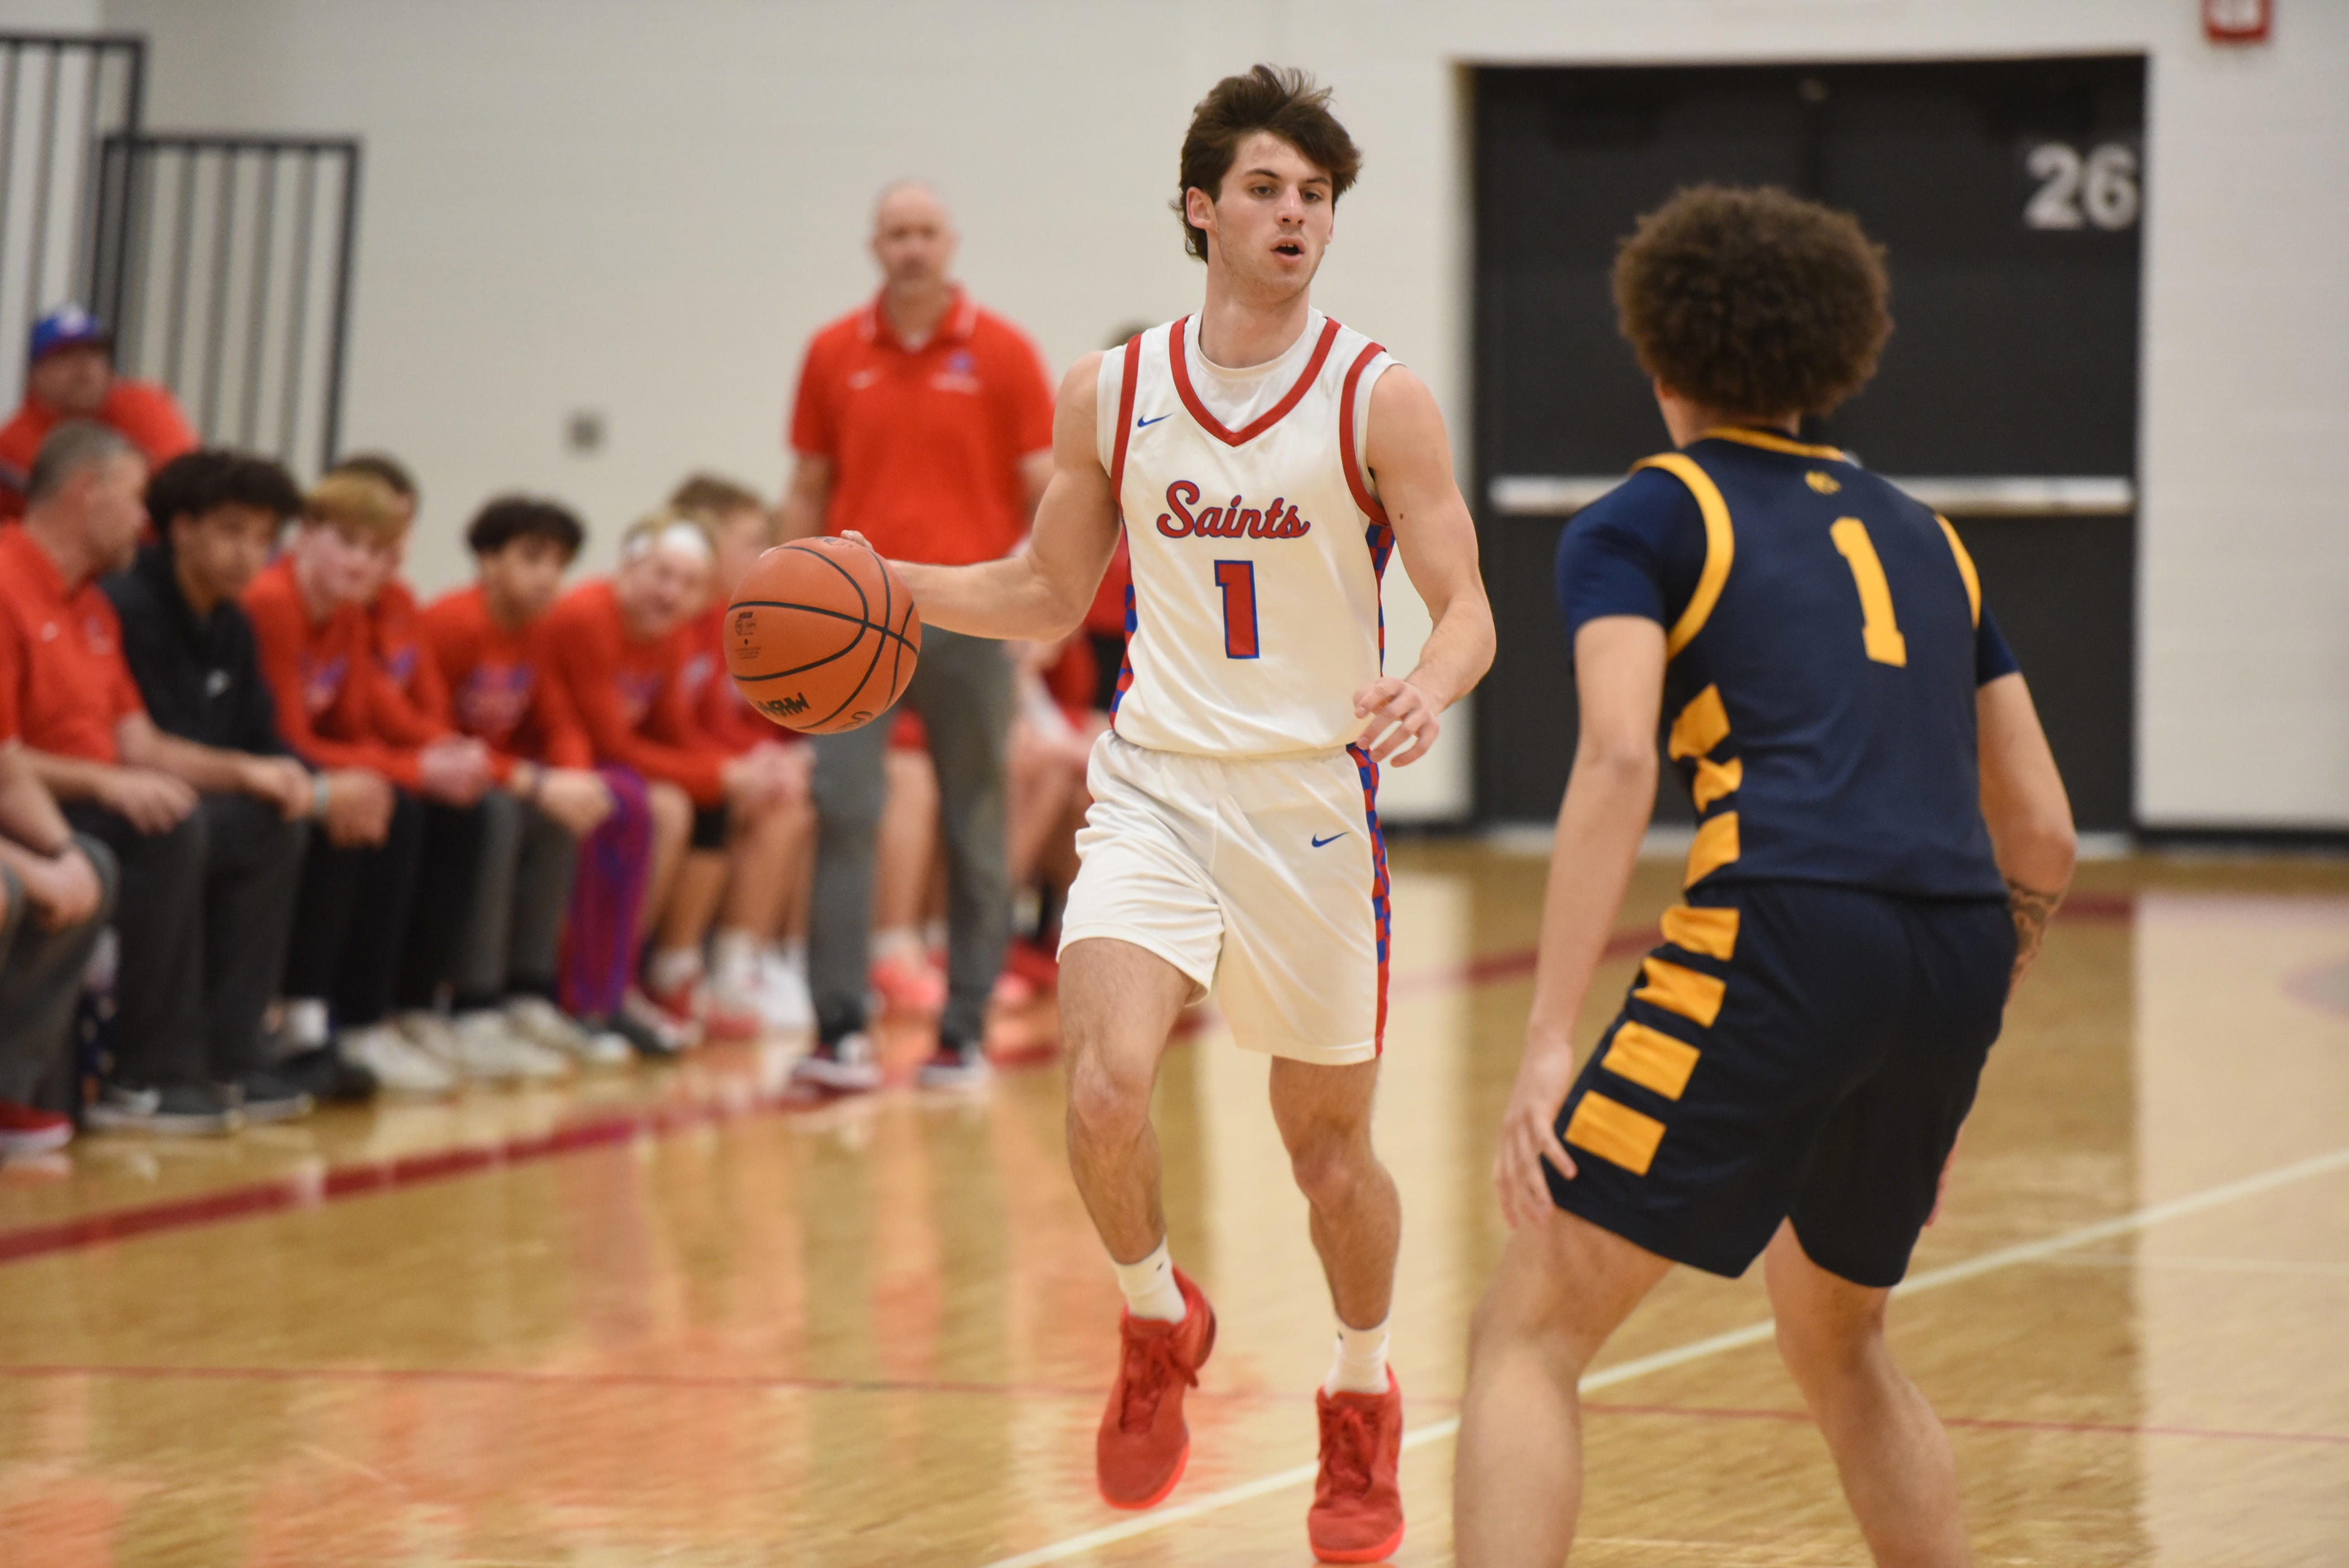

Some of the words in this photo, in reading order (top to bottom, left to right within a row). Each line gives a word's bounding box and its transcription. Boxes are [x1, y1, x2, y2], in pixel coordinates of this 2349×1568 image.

[2024, 142, 2138, 230] 26
[1156, 479, 1311, 539] Saints
[1213, 559, 1260, 659] 1
[1829, 516, 1907, 668] 1
